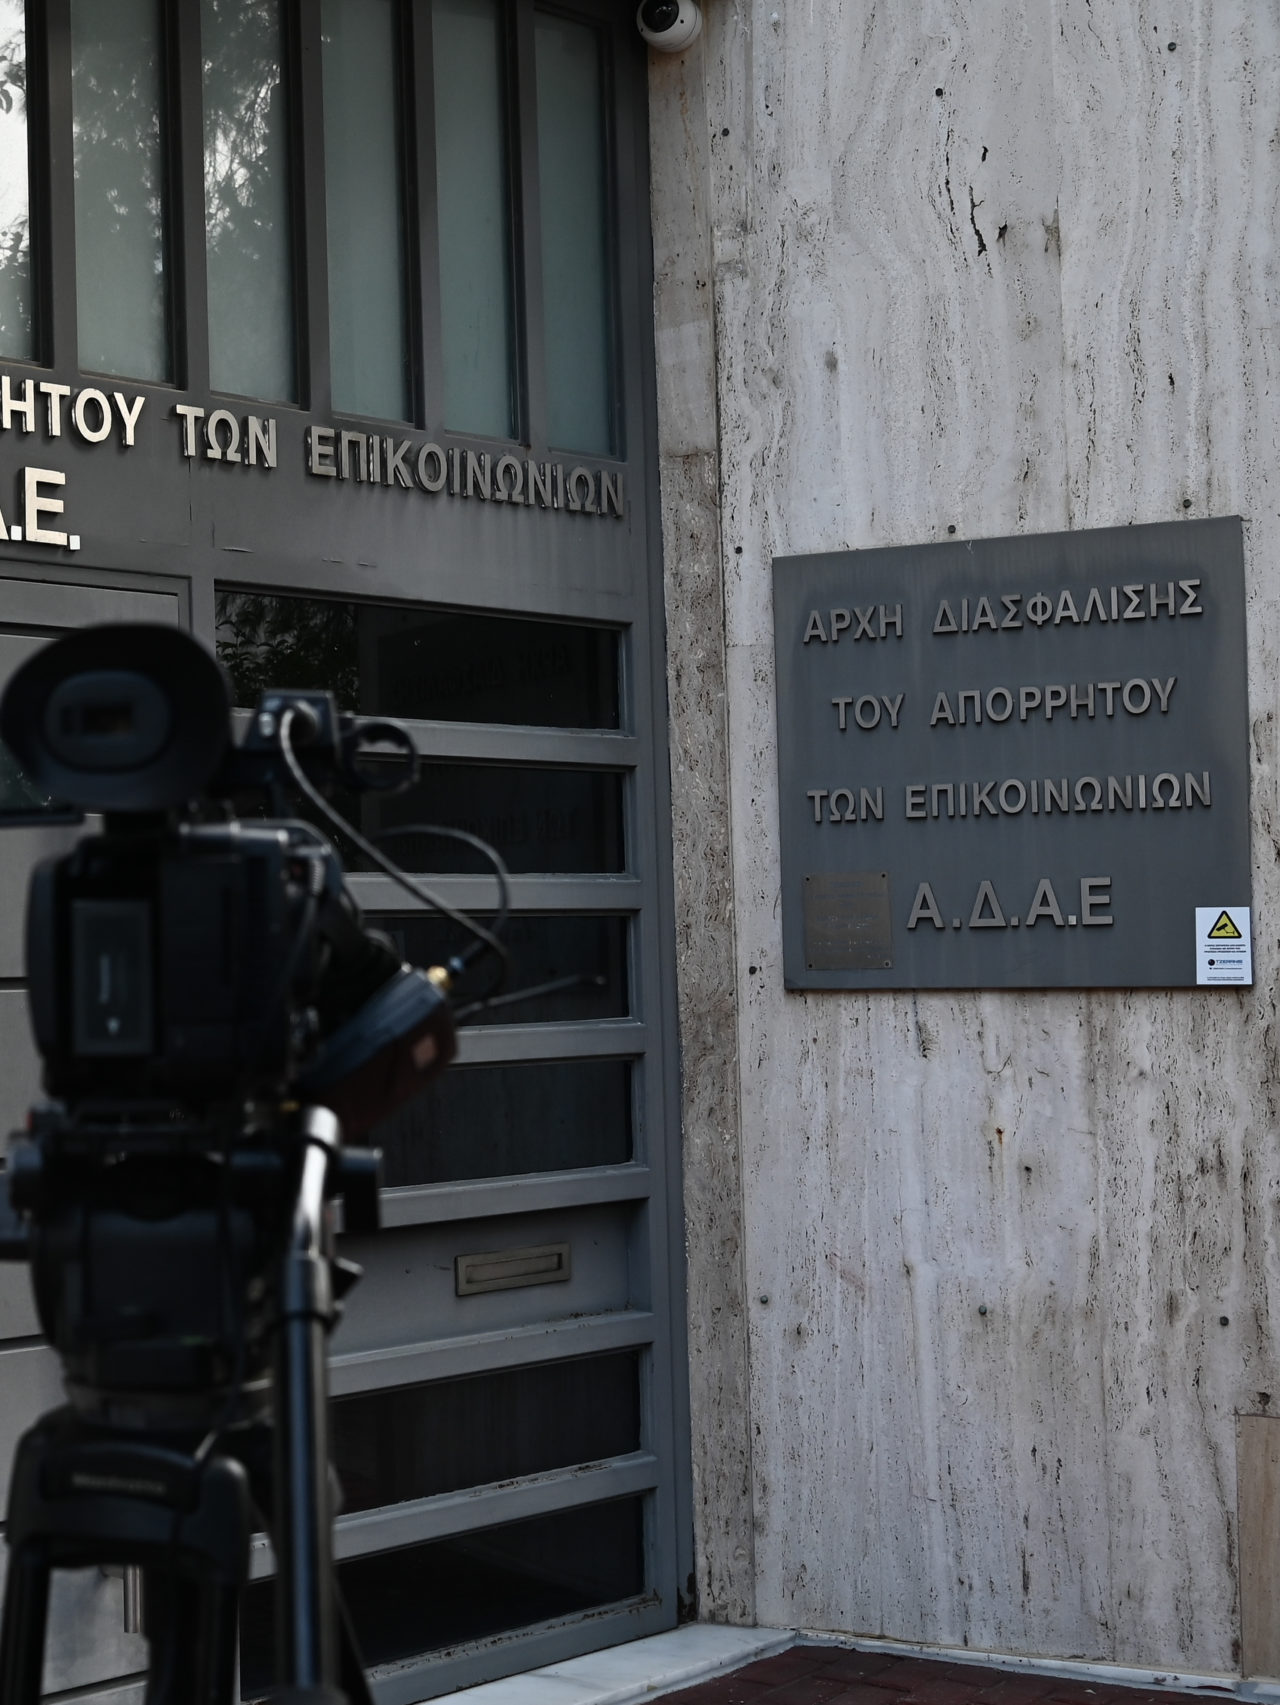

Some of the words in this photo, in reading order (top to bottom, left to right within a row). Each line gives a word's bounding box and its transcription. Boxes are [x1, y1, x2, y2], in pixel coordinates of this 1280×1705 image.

[175, 403, 277, 470] ΤΩΝ
[309, 425, 626, 518] ΕΠΙΚΟΙΝΩΝΙΩΝ
[803, 603, 904, 644] ΑΡΧΗ
[932, 578, 1204, 634] ΔΙΑΣΦΑΛΙΣΗΣ
[831, 693, 905, 730] ΤΟΥ
[929, 676, 1178, 727] ΑΠΟΡΡΗΤΟΥ
[806, 786, 885, 823] ΤΩΝ
[905, 770, 1212, 820] ΕΠΙΚΟΙΝΩΝΙΩΝ
[906, 876, 1115, 930] Α.Δ.Α.Ε
